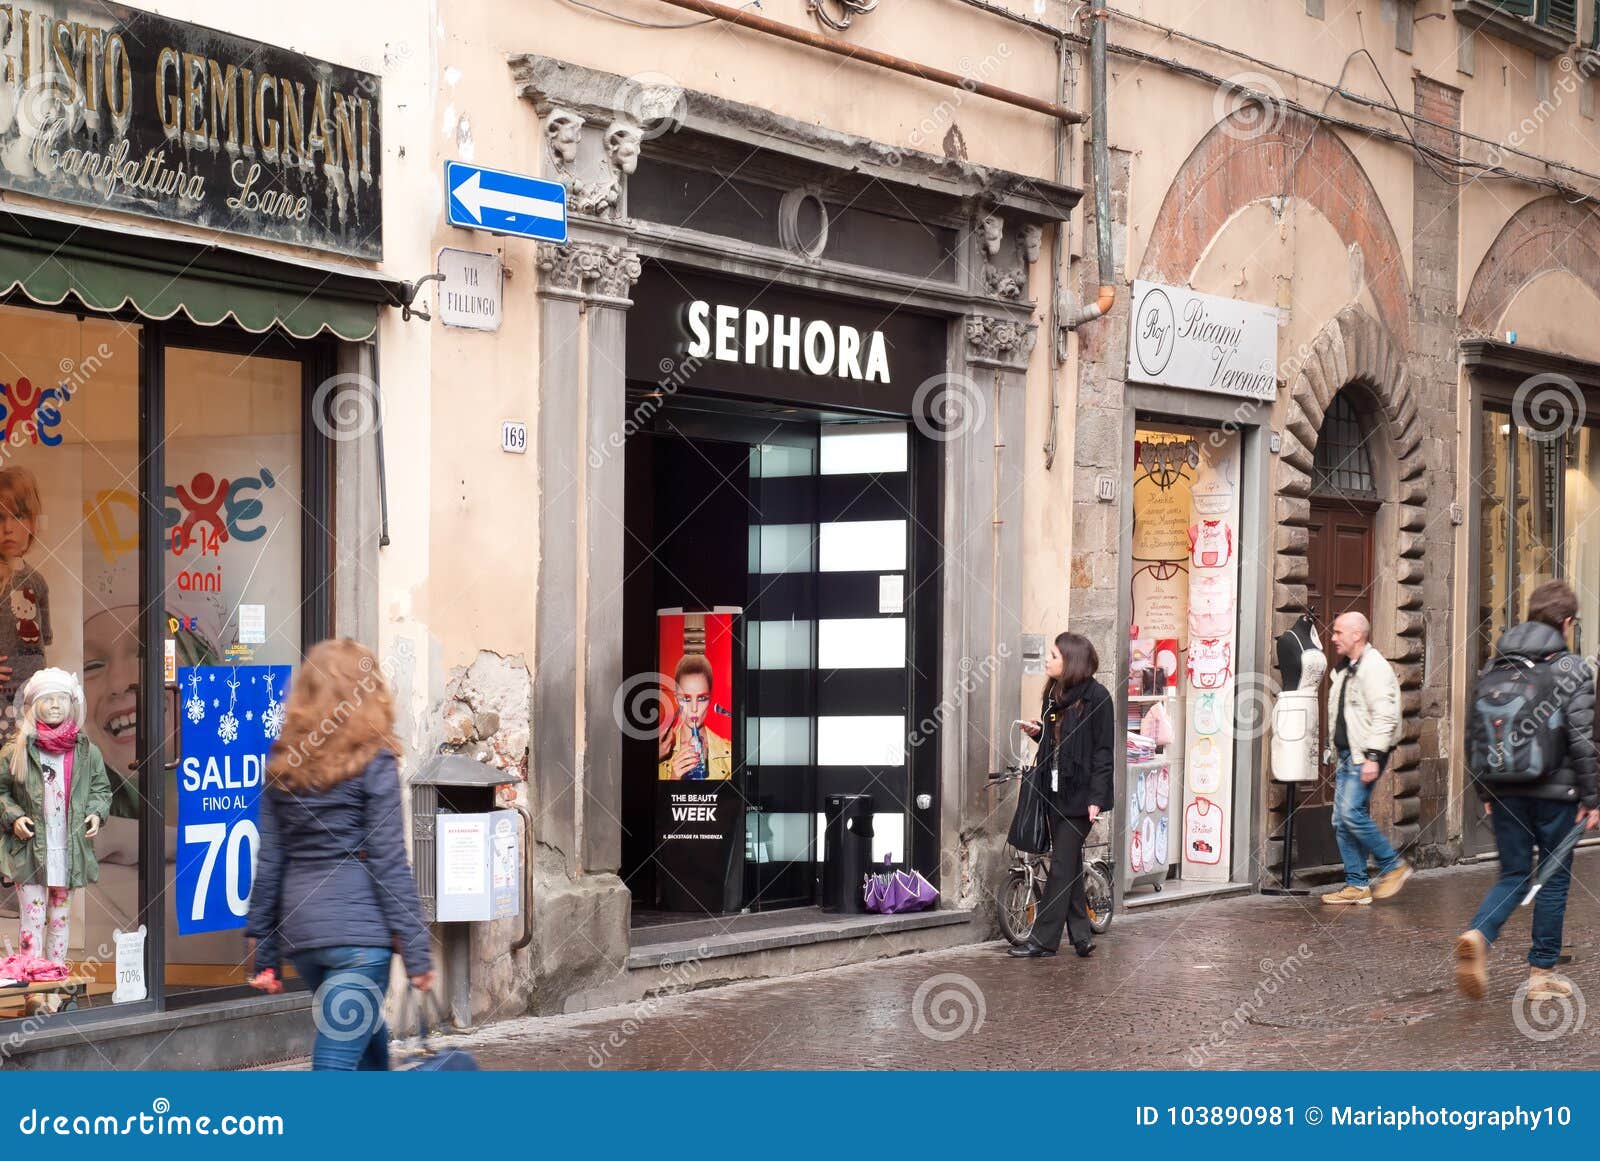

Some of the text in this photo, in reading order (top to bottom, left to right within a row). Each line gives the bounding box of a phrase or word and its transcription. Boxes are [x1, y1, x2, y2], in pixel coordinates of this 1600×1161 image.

[155, 47, 372, 173] GEMIGNANI
[32, 113, 311, 221] Manifattura Lane
[463, 266, 479, 287] VIA
[448, 291, 495, 317] FILLUNGO
[1178, 298, 1245, 347] Ricami
[687, 299, 892, 385] SEPHORA
[1210, 345, 1275, 395] Veronica
[504, 426, 525, 447] 169
[1101, 480, 1113, 496] 171
[171, 526, 220, 556] 0-14
[177, 565, 222, 592] anni
[182, 752, 267, 792] SALDI
[202, 795, 248, 812] FINO AL
[671, 794, 719, 802] THE BEAUTY
[671, 807, 718, 822] WEEK
[184, 818, 262, 921] 70
[120, 969, 141, 985] 70%
